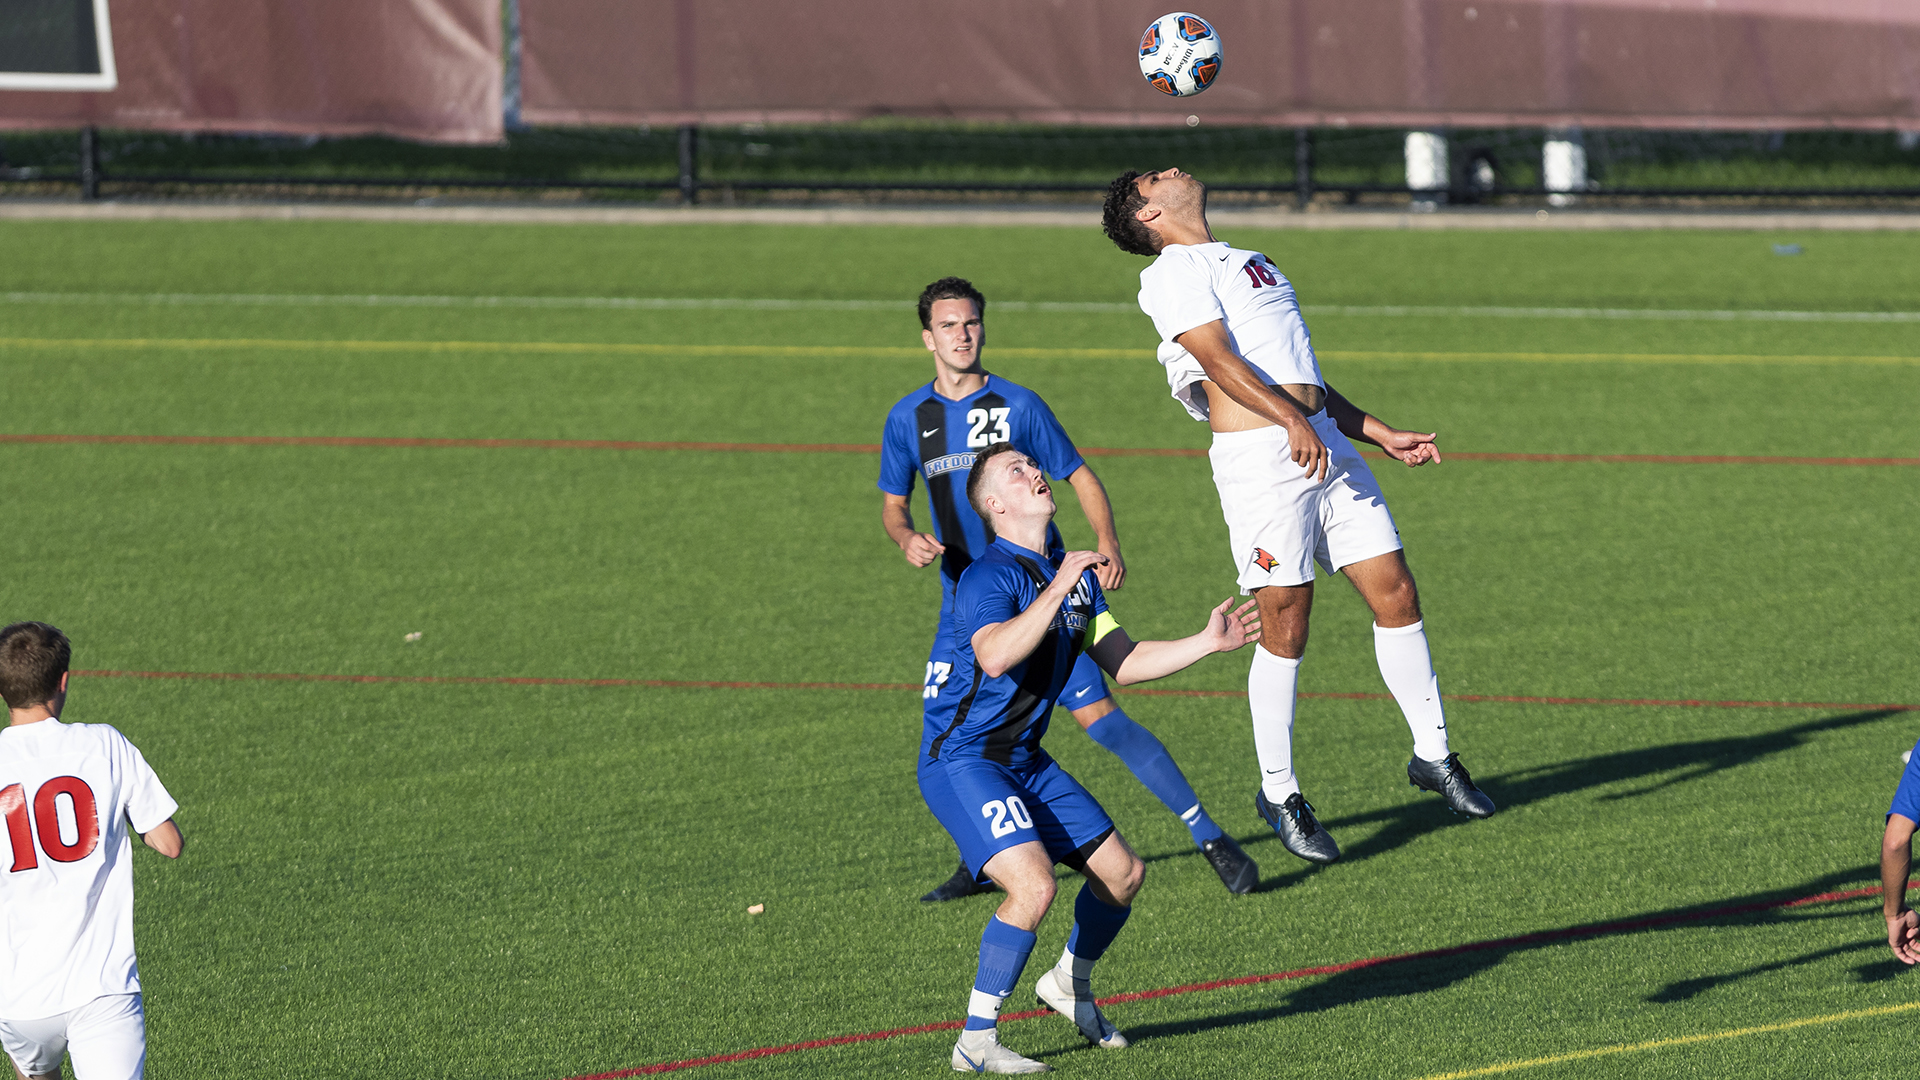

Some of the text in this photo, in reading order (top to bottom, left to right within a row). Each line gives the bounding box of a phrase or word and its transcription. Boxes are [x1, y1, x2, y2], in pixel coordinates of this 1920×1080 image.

[1174, 48, 1194, 74] Wilson
[966, 407, 1011, 448] 23
[0, 775, 100, 873] 10
[981, 796, 1034, 839] 20
